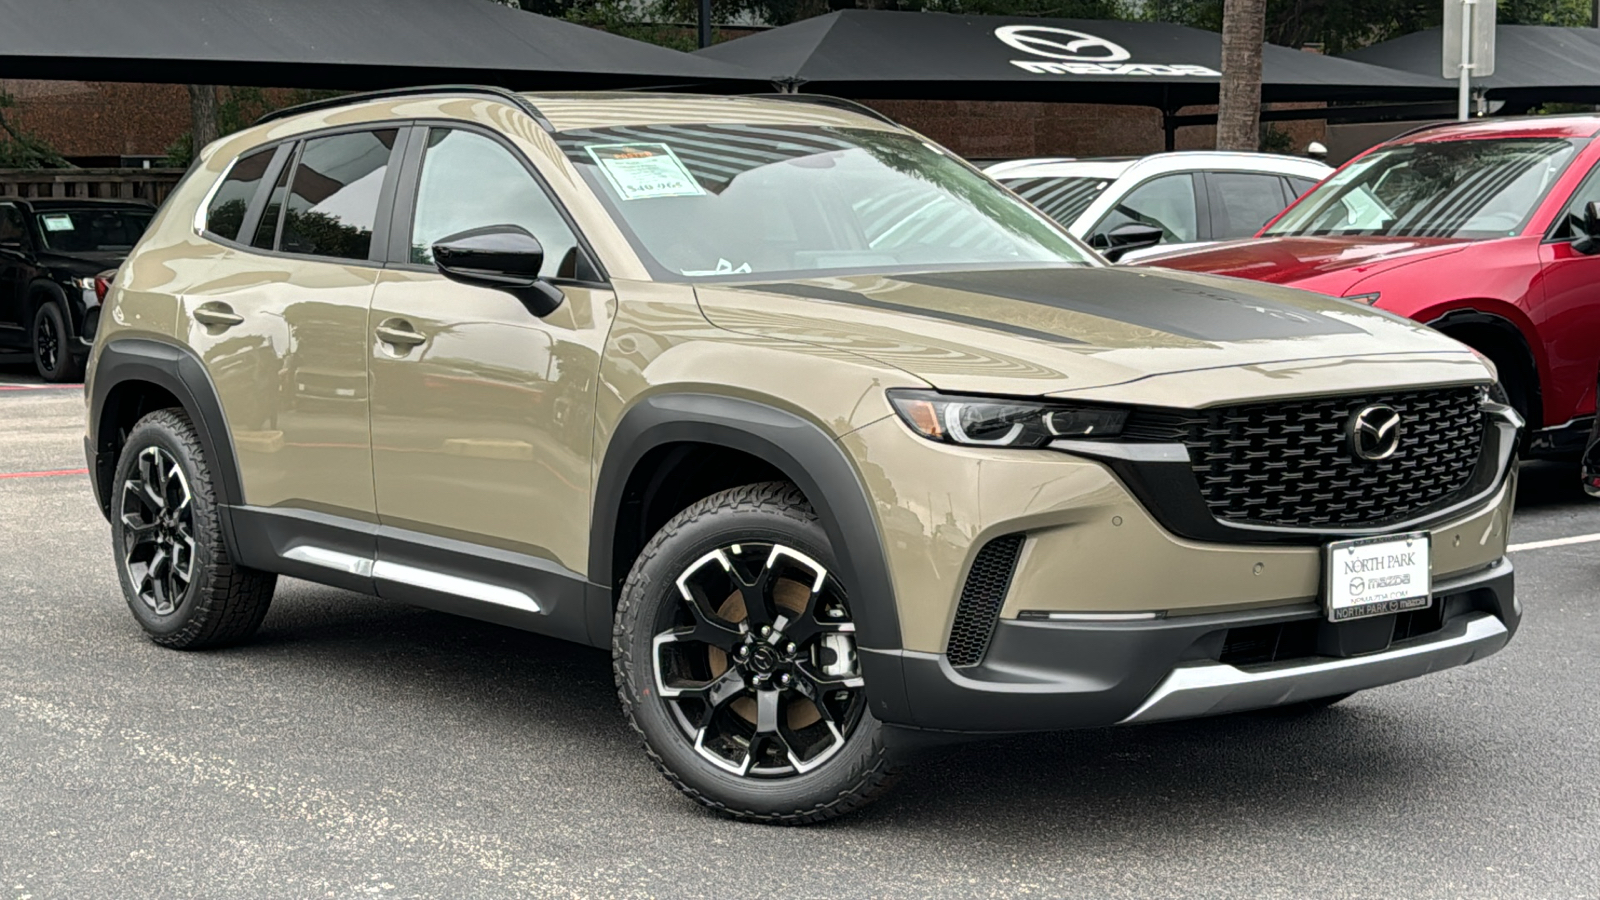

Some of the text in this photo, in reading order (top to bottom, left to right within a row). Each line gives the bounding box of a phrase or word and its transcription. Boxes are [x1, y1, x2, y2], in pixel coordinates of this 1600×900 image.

[1344, 552, 1416, 574] NORTH PARK
[1367, 573, 1411, 589] mazda
[1336, 597, 1426, 618] NORTH PARK mazda
